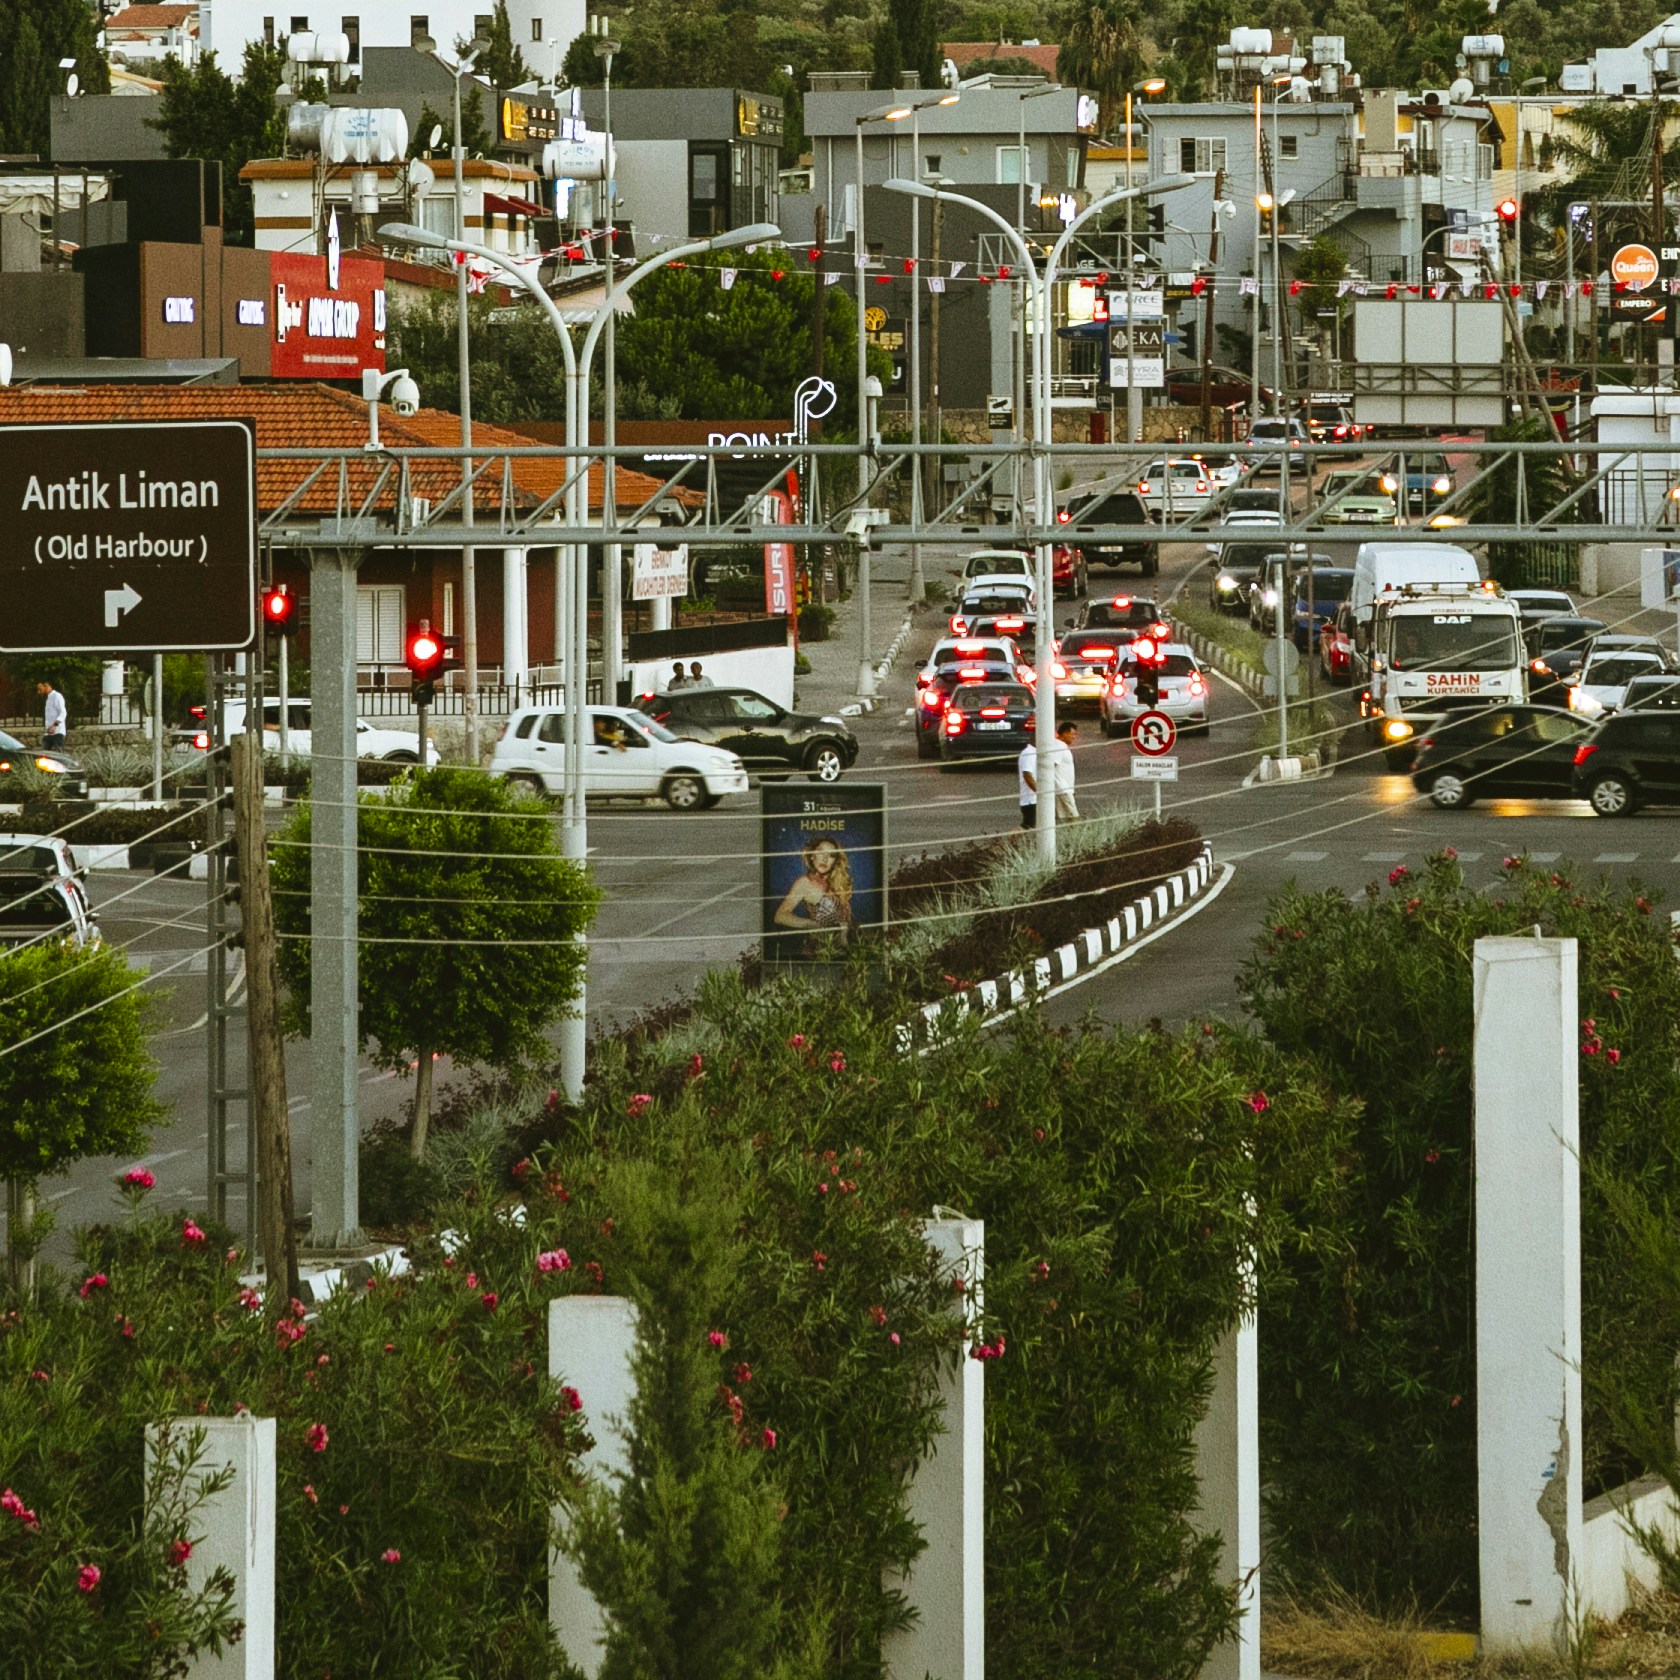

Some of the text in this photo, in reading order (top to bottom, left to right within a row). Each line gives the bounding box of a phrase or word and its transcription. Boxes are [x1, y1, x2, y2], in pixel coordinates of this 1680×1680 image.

[1616, 262, 1654, 273] Queen
[21, 470, 219, 510] Antik Liman
[1434, 616, 1472, 624] DAF
[803, 801, 815, 811] 31
[800, 817, 845, 831] HADİSE
